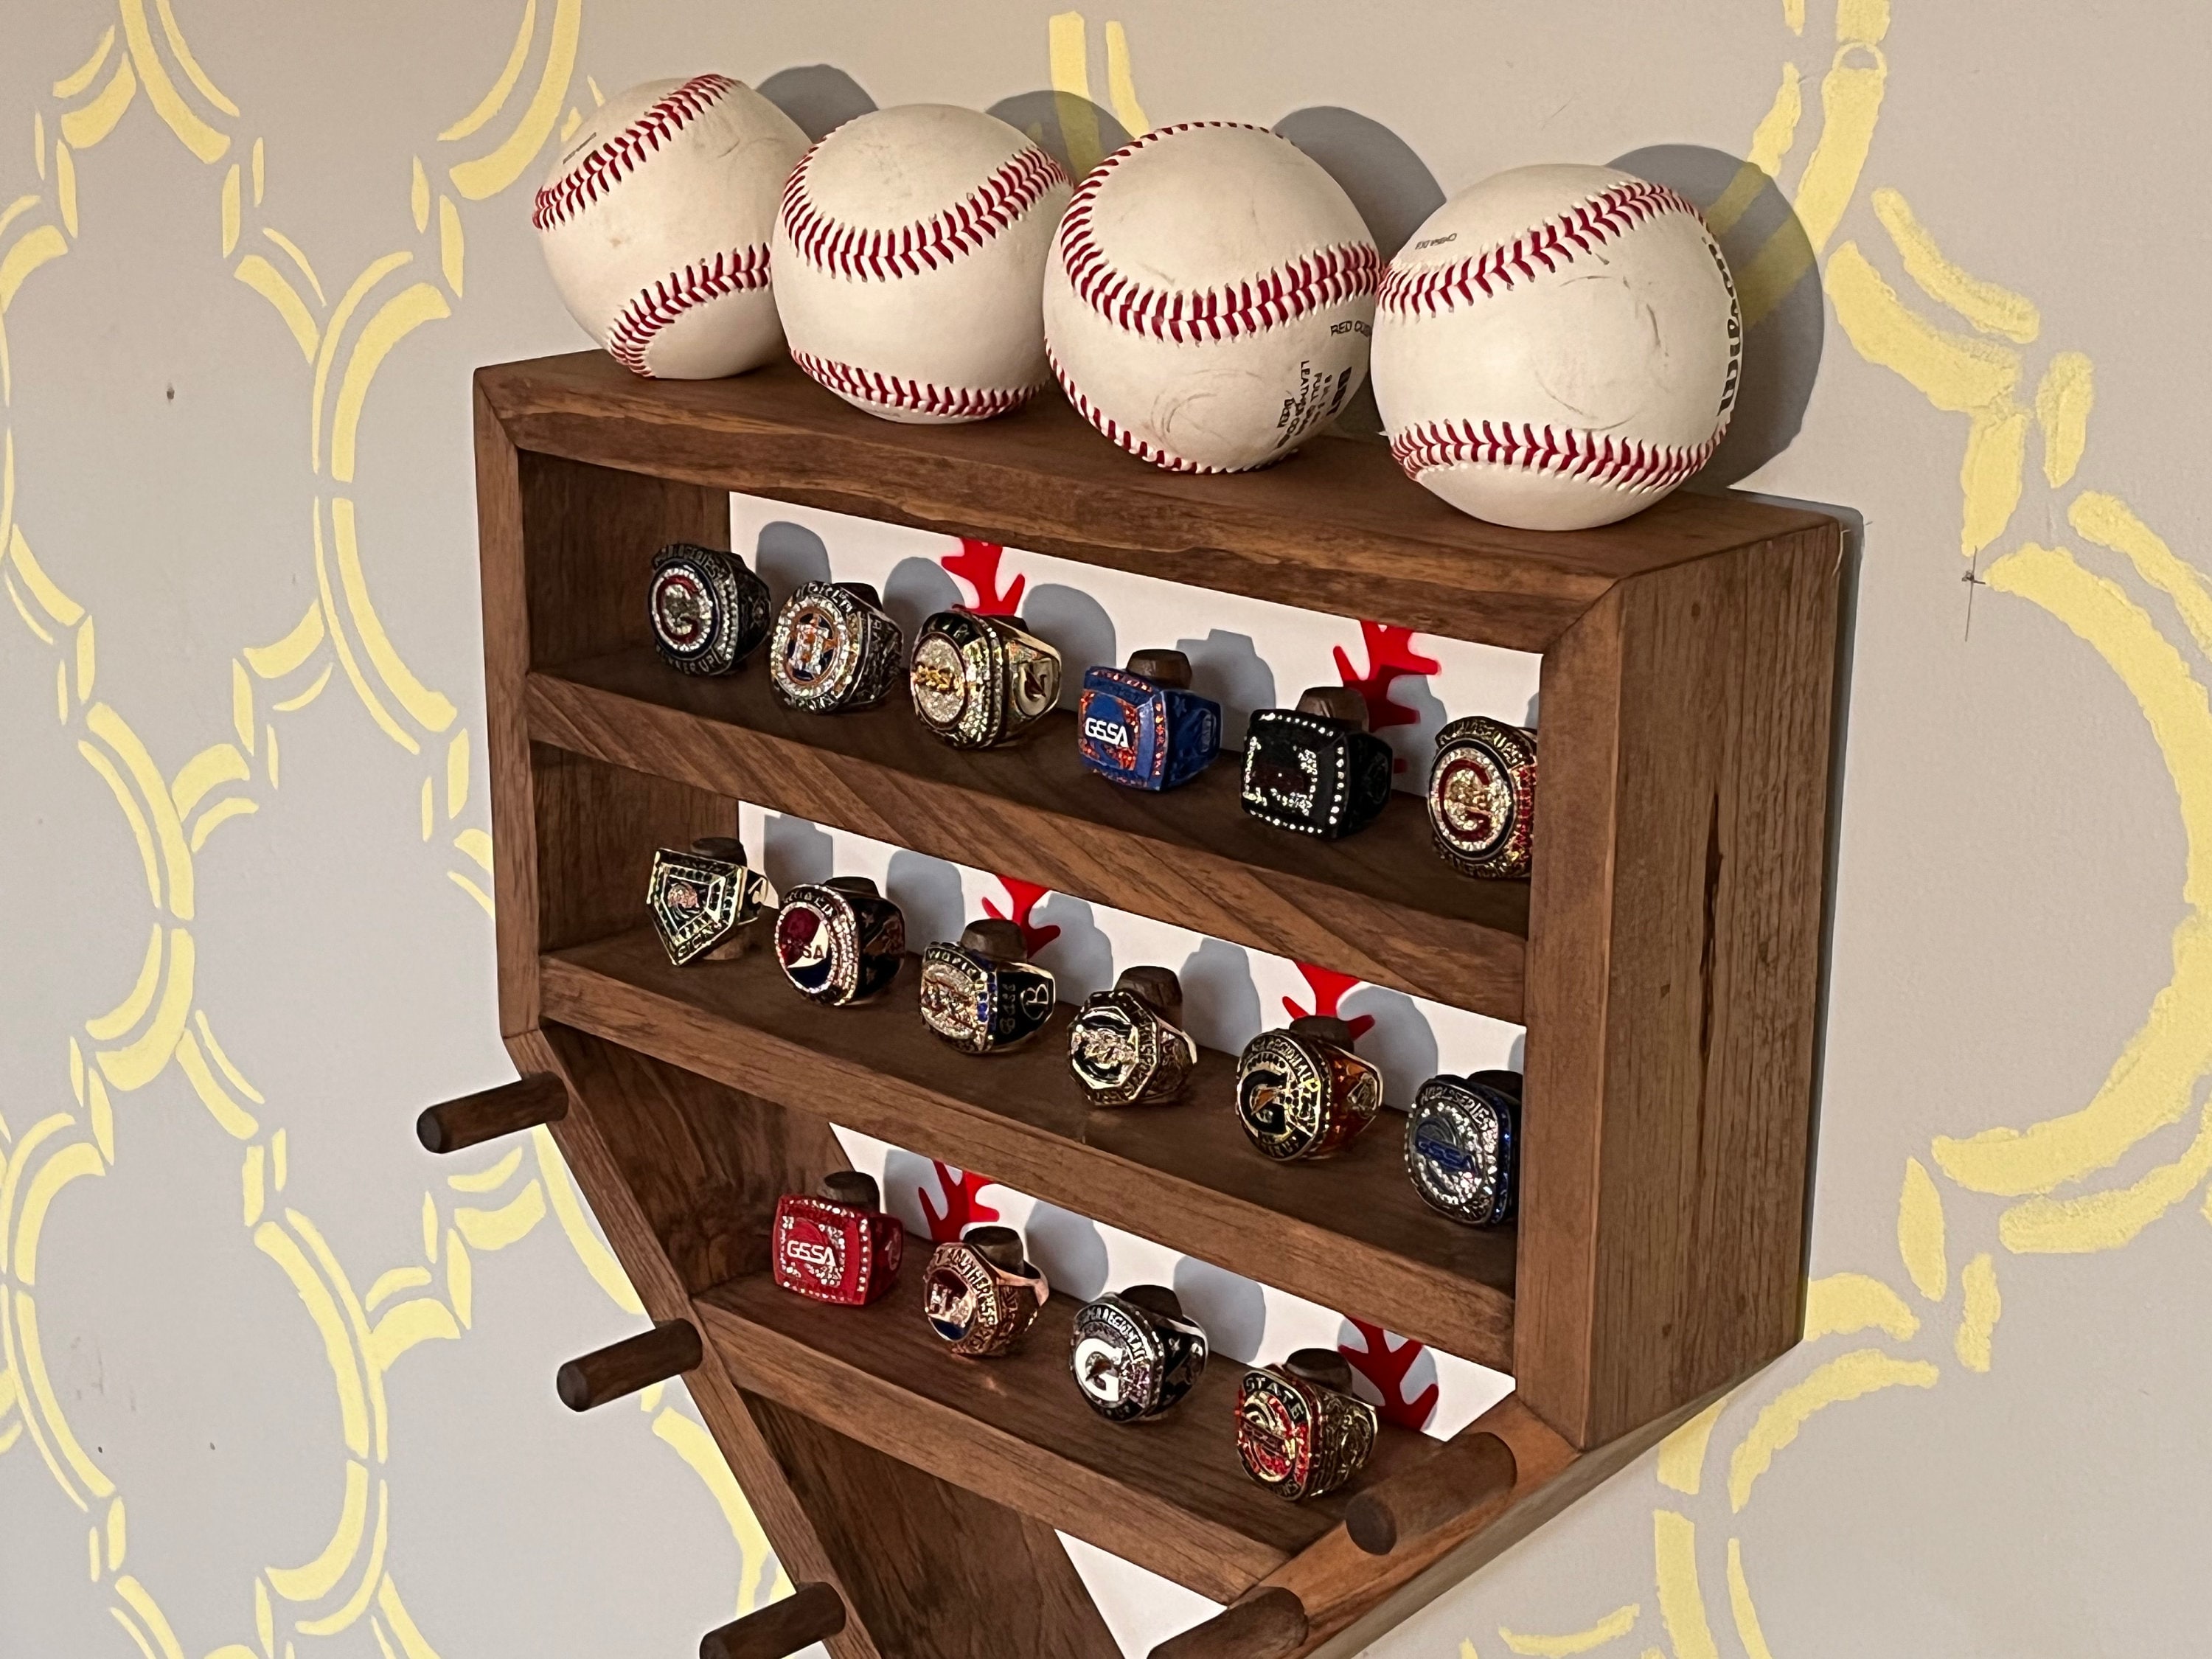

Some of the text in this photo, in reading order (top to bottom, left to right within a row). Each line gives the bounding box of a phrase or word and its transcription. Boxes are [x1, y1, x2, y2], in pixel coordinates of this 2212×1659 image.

[1330, 320, 1352, 337] RED
[1085, 717, 1129, 748] GSSA
[787, 1240, 836, 1267] GSSA
[1246, 1377, 1304, 1420] STATE
